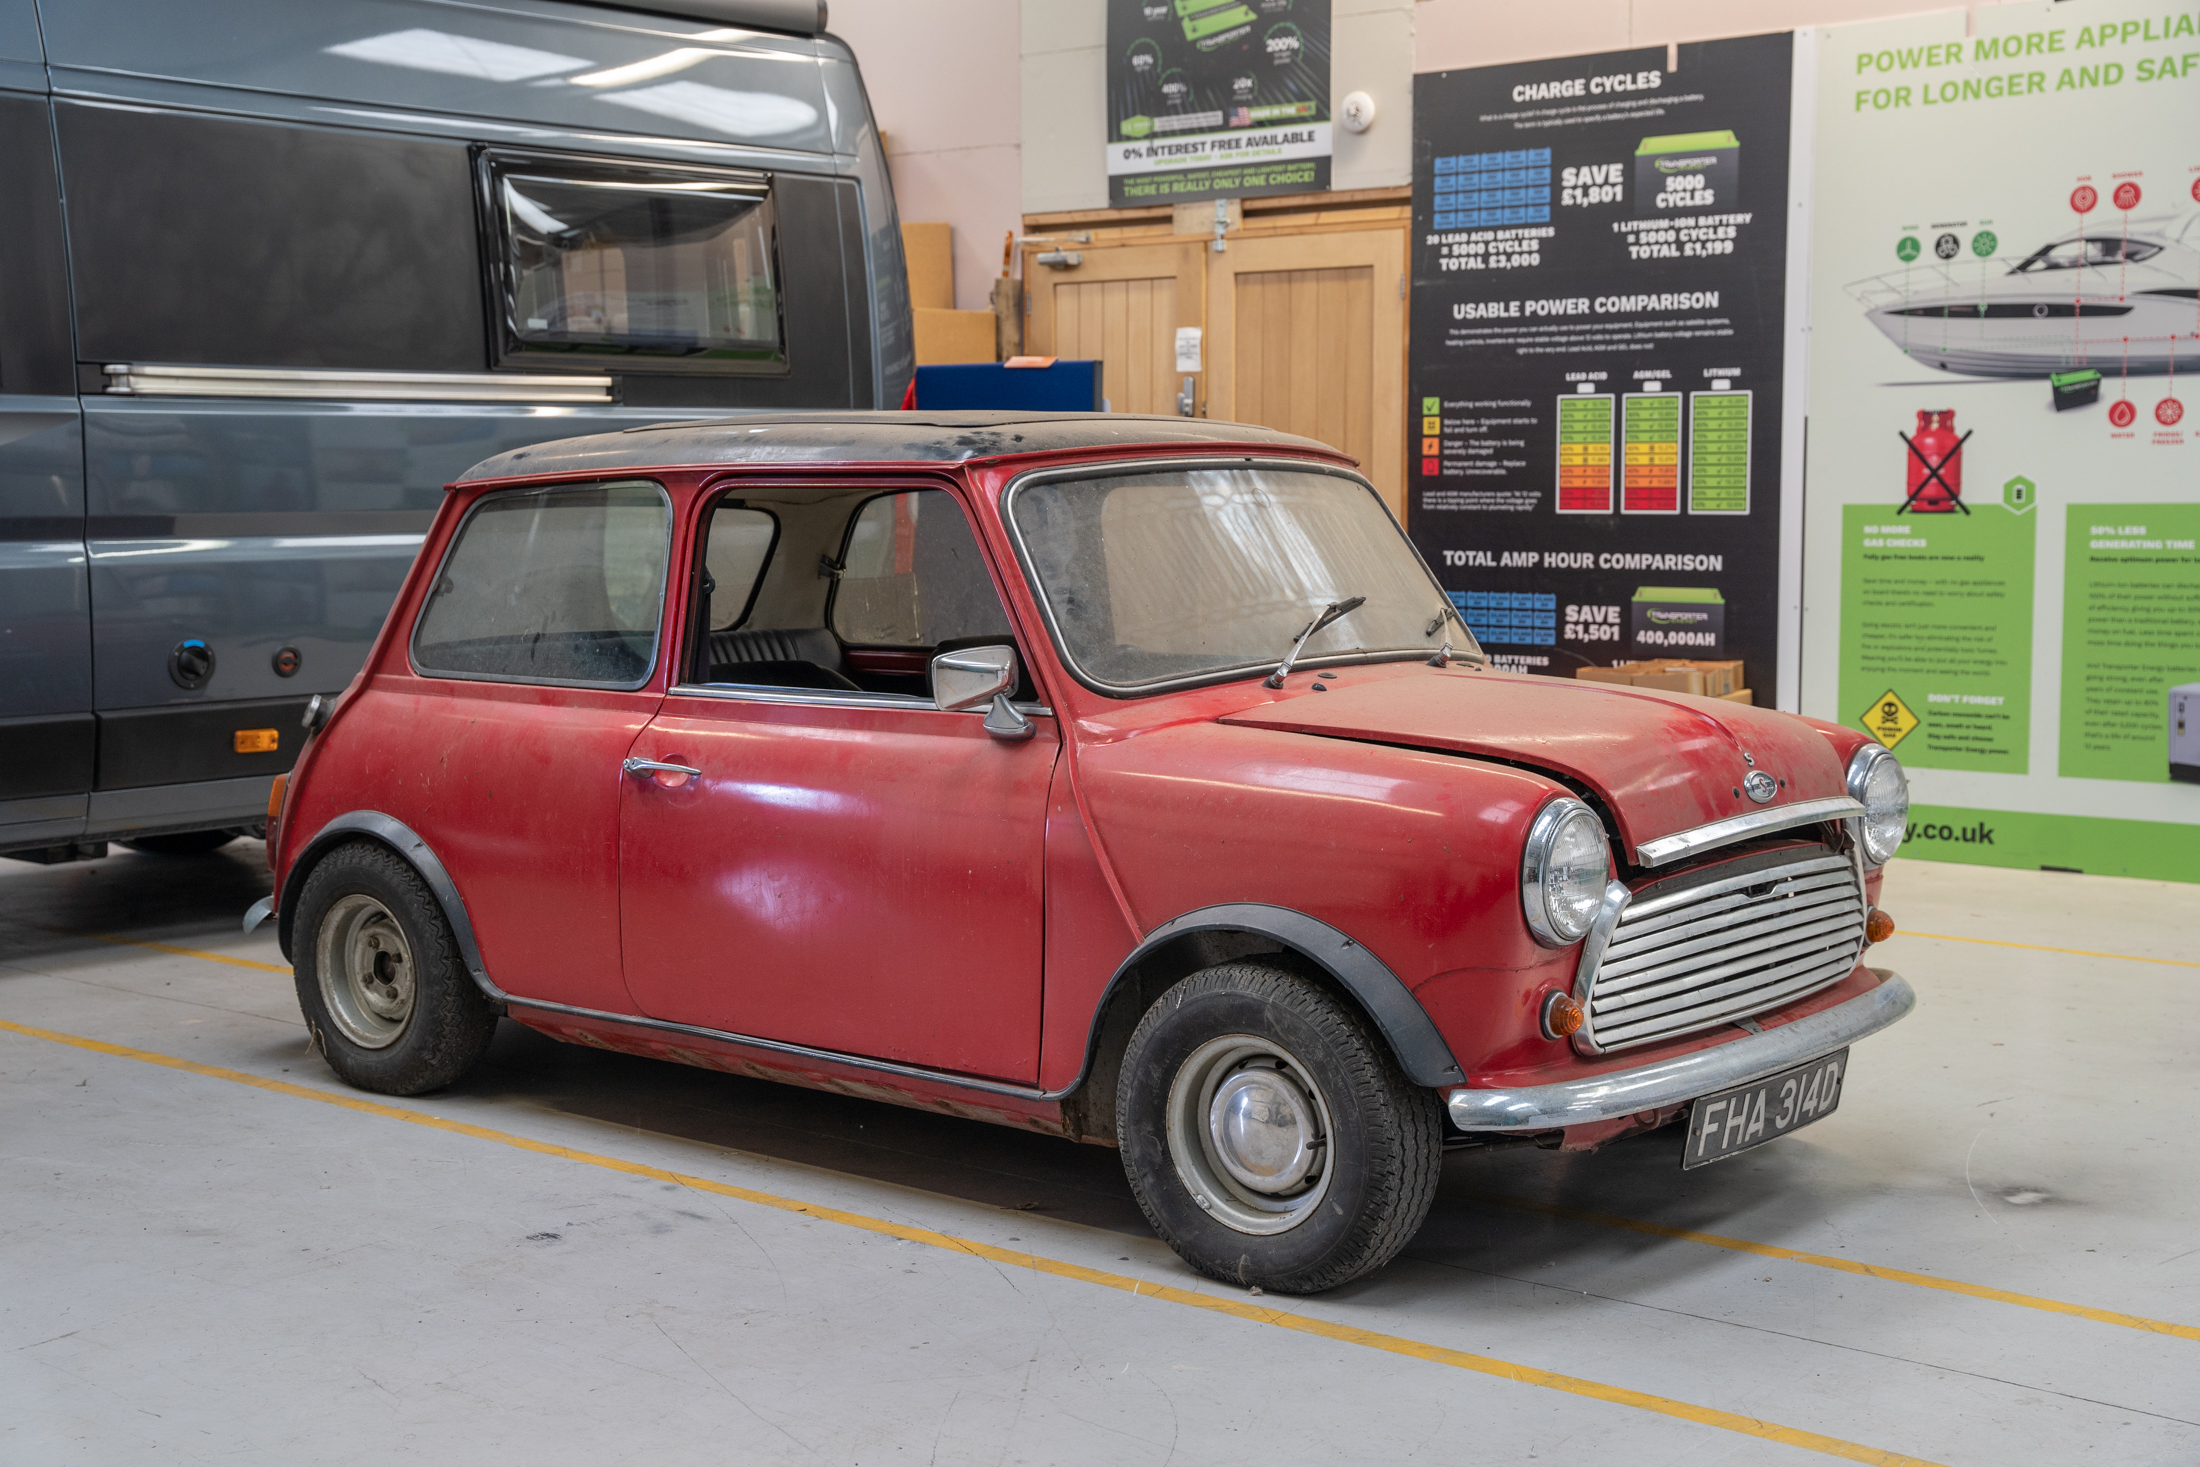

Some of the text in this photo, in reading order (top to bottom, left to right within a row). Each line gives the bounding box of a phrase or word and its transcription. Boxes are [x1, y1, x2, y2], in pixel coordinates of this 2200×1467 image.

[1266, 35, 1300, 52] 200%
[1856, 12, 2200, 75] POWER MORE APPLIA
[1512, 70, 1662, 103] CHARGE CYCLES
[1855, 52, 2200, 112] FOR LONGER AND SAF
[1123, 130, 1316, 160] 0% INTEREST FREE AVAILABLE
[1123, 170, 1314, 197] THERE IS REALLY ONLY ONE CHOICE!
[1562, 162, 1624, 188] SAVE
[1666, 174, 1705, 192] 5000
[2112, 170, 2144, 179] SHOWER
[1561, 184, 1624, 208] £1,801
[1656, 188, 1715, 208] CYCLES
[1612, 222, 1619, 233] 1
[1698, 212, 1753, 228] BATTERY
[1426, 226, 1555, 245] 20 LEAD ACID BATTERIES
[1639, 229, 1676, 244] 5000
[1679, 225, 1737, 242] CYCLES
[1452, 242, 1486, 256] 5000
[1488, 239, 1540, 254] CYCLES
[1628, 240, 1734, 260] TOTAL £1,199
[1439, 252, 1540, 272] TOTAL £3,000
[1453, 291, 1720, 320] USABLE POWER COMPARISON
[1566, 371, 1608, 382] LEAD ACID
[1703, 368, 1741, 378] LITHIUM
[1864, 525, 1912, 534] NO MORE
[2118, 525, 2146, 536] LESS
[1863, 538, 1927, 548] GAS CHECKS
[2090, 539, 2196, 550] GENERATING TIME
[1443, 550, 1723, 572] TOTAL AMP HOUR COMPARISON
[1564, 604, 1621, 624] SAVE
[1652, 610, 1708, 621] TRANSPORTER
[1564, 624, 1620, 643] £1,501
[1636, 630, 1716, 647] 400,000AH
[1494, 654, 1550, 666] BATTERIES
[1962, 695, 2004, 706] FORGET
[1901, 822, 1994, 845] y.co.uk
[1697, 1061, 1840, 1157] FHA 314D
